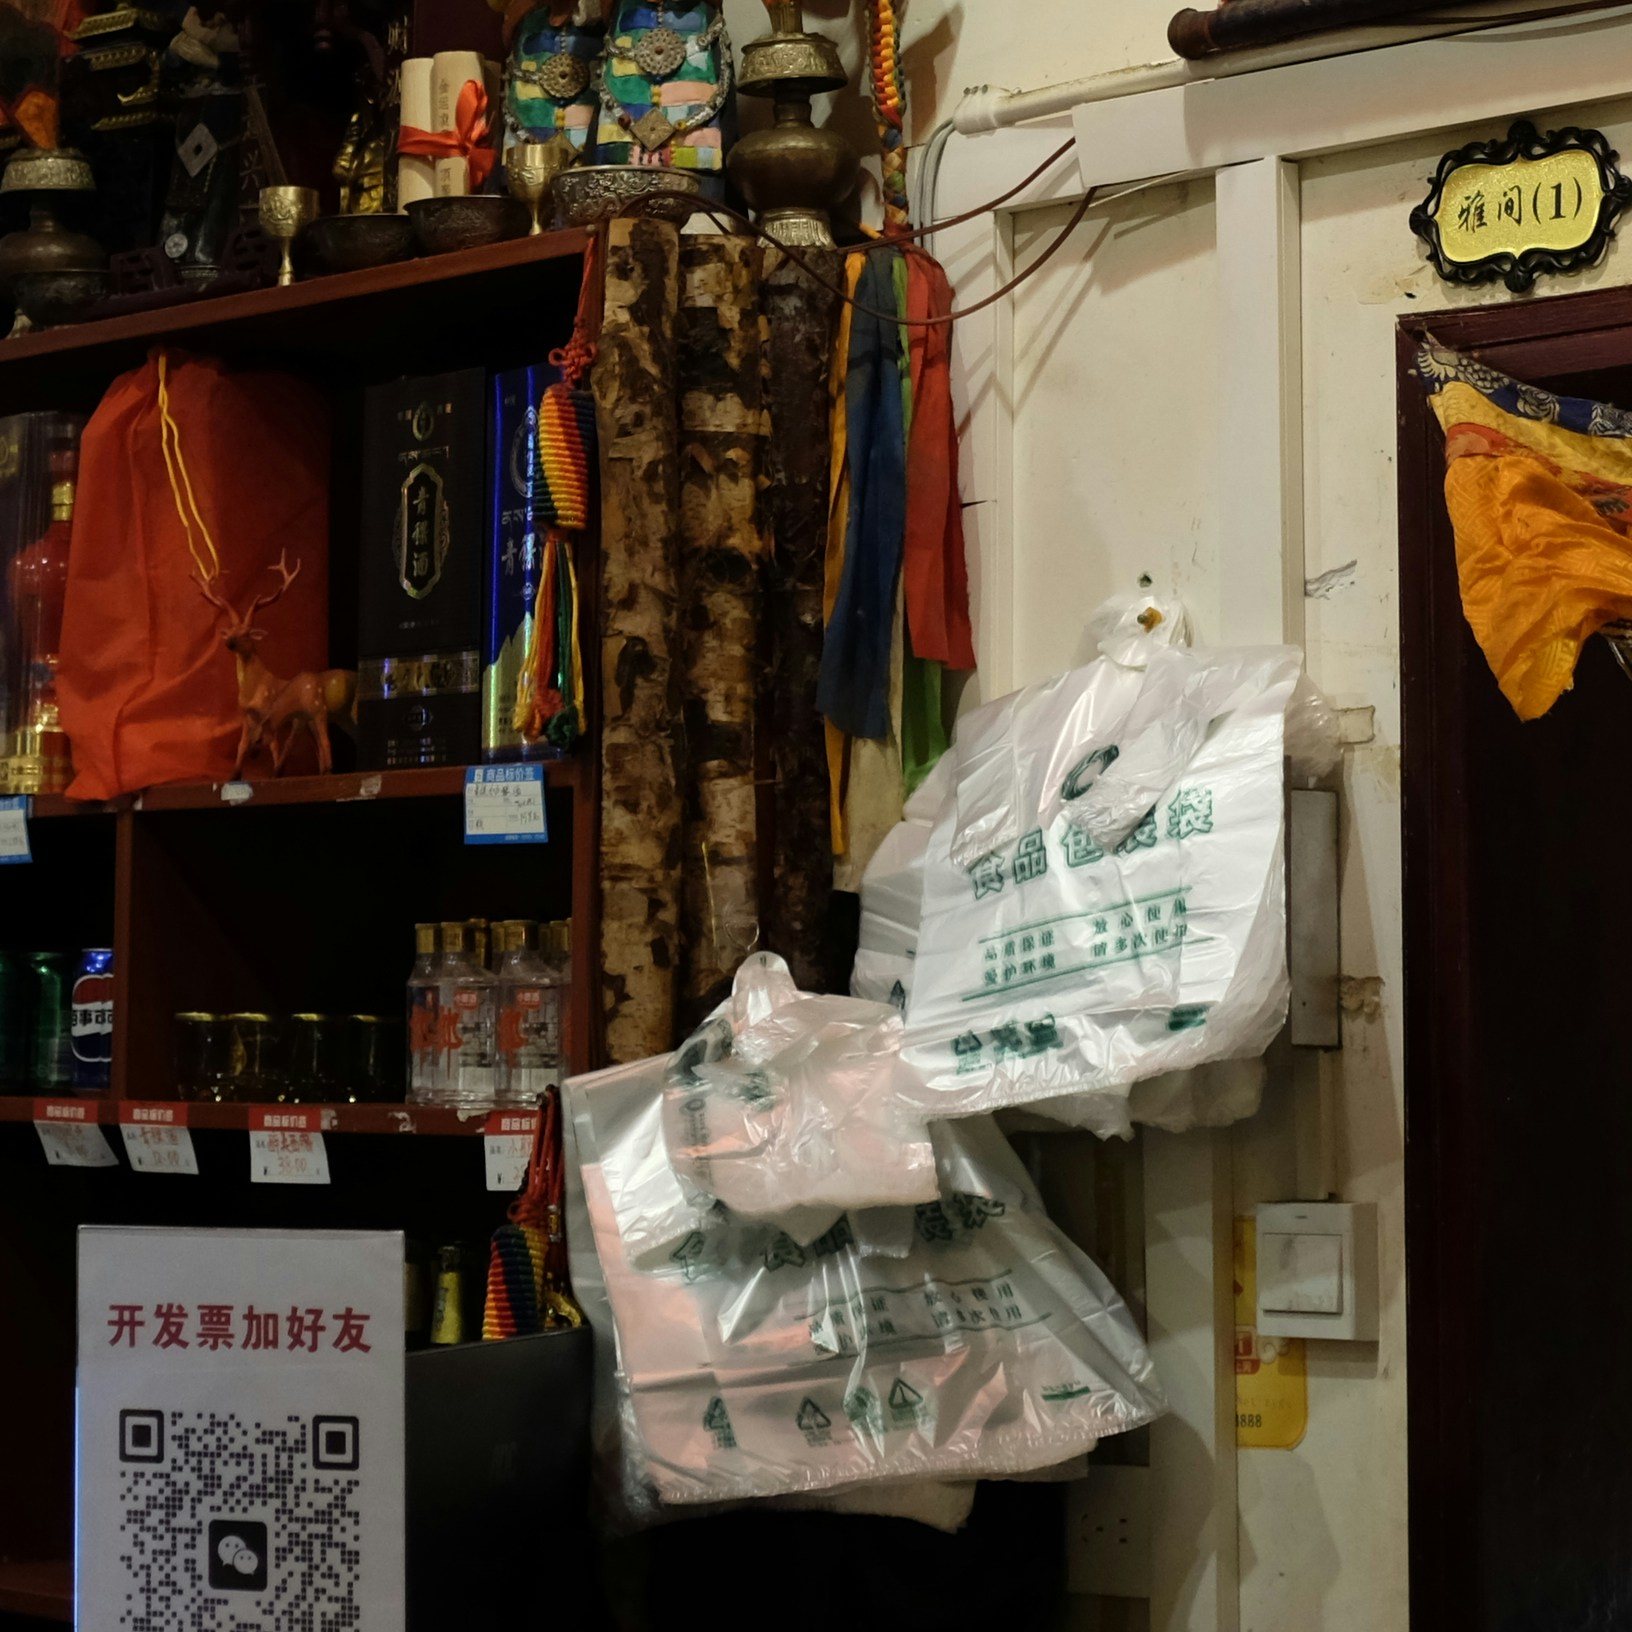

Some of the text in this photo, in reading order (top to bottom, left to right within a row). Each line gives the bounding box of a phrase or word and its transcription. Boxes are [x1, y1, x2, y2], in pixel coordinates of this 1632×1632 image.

[1457, 176, 1583, 233] 雅间(1)
[106, 1302, 372, 1354] 开发票加好友
